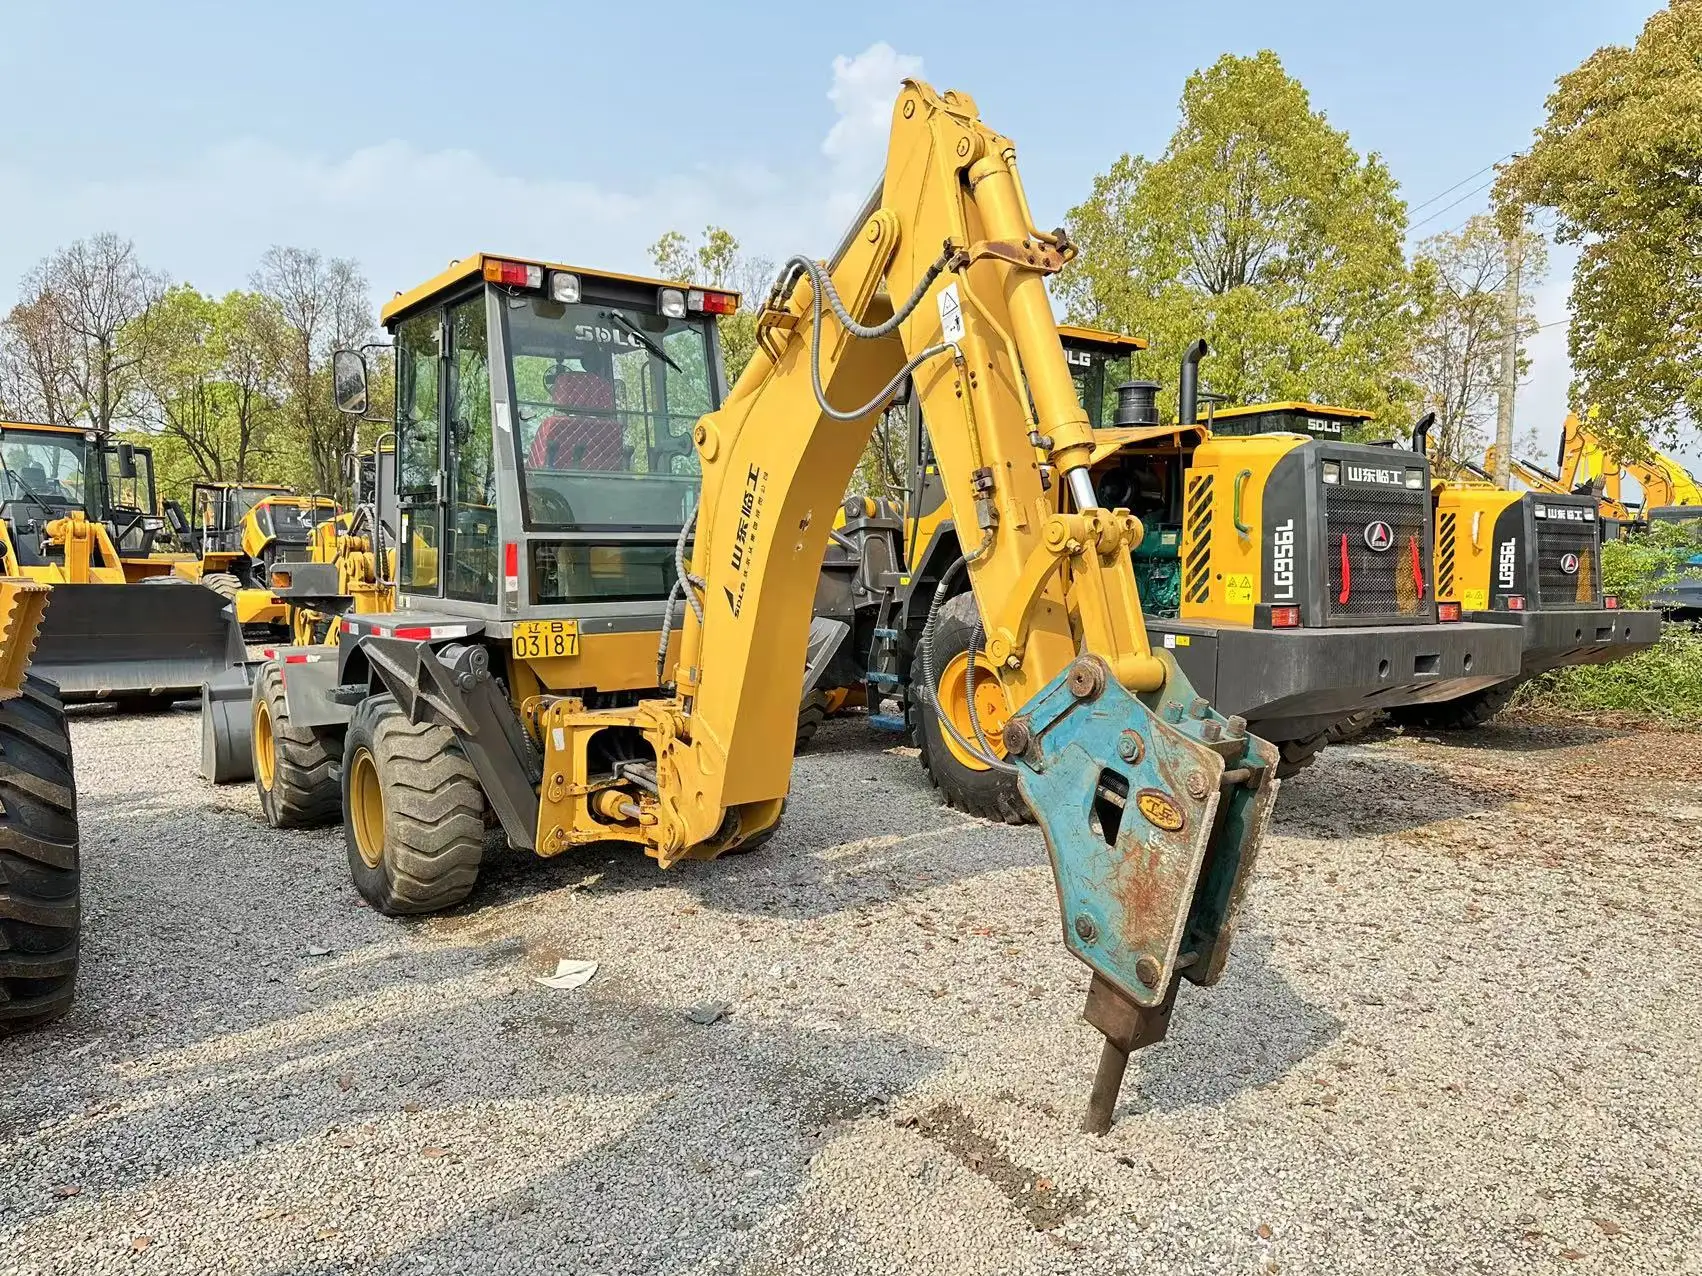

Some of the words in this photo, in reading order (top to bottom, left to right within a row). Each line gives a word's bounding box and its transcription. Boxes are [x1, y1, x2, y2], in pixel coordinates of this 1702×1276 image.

[1064, 350, 1091, 366] LG
[1307, 419, 1341, 433] SDLG
[1347, 466, 1403, 485] 山东临工
[731, 463, 760, 571] 山东临工
[1273, 518, 1294, 599] LG956L
[1498, 537, 1516, 589] LG956L
[515, 634, 577, 657] 03187
